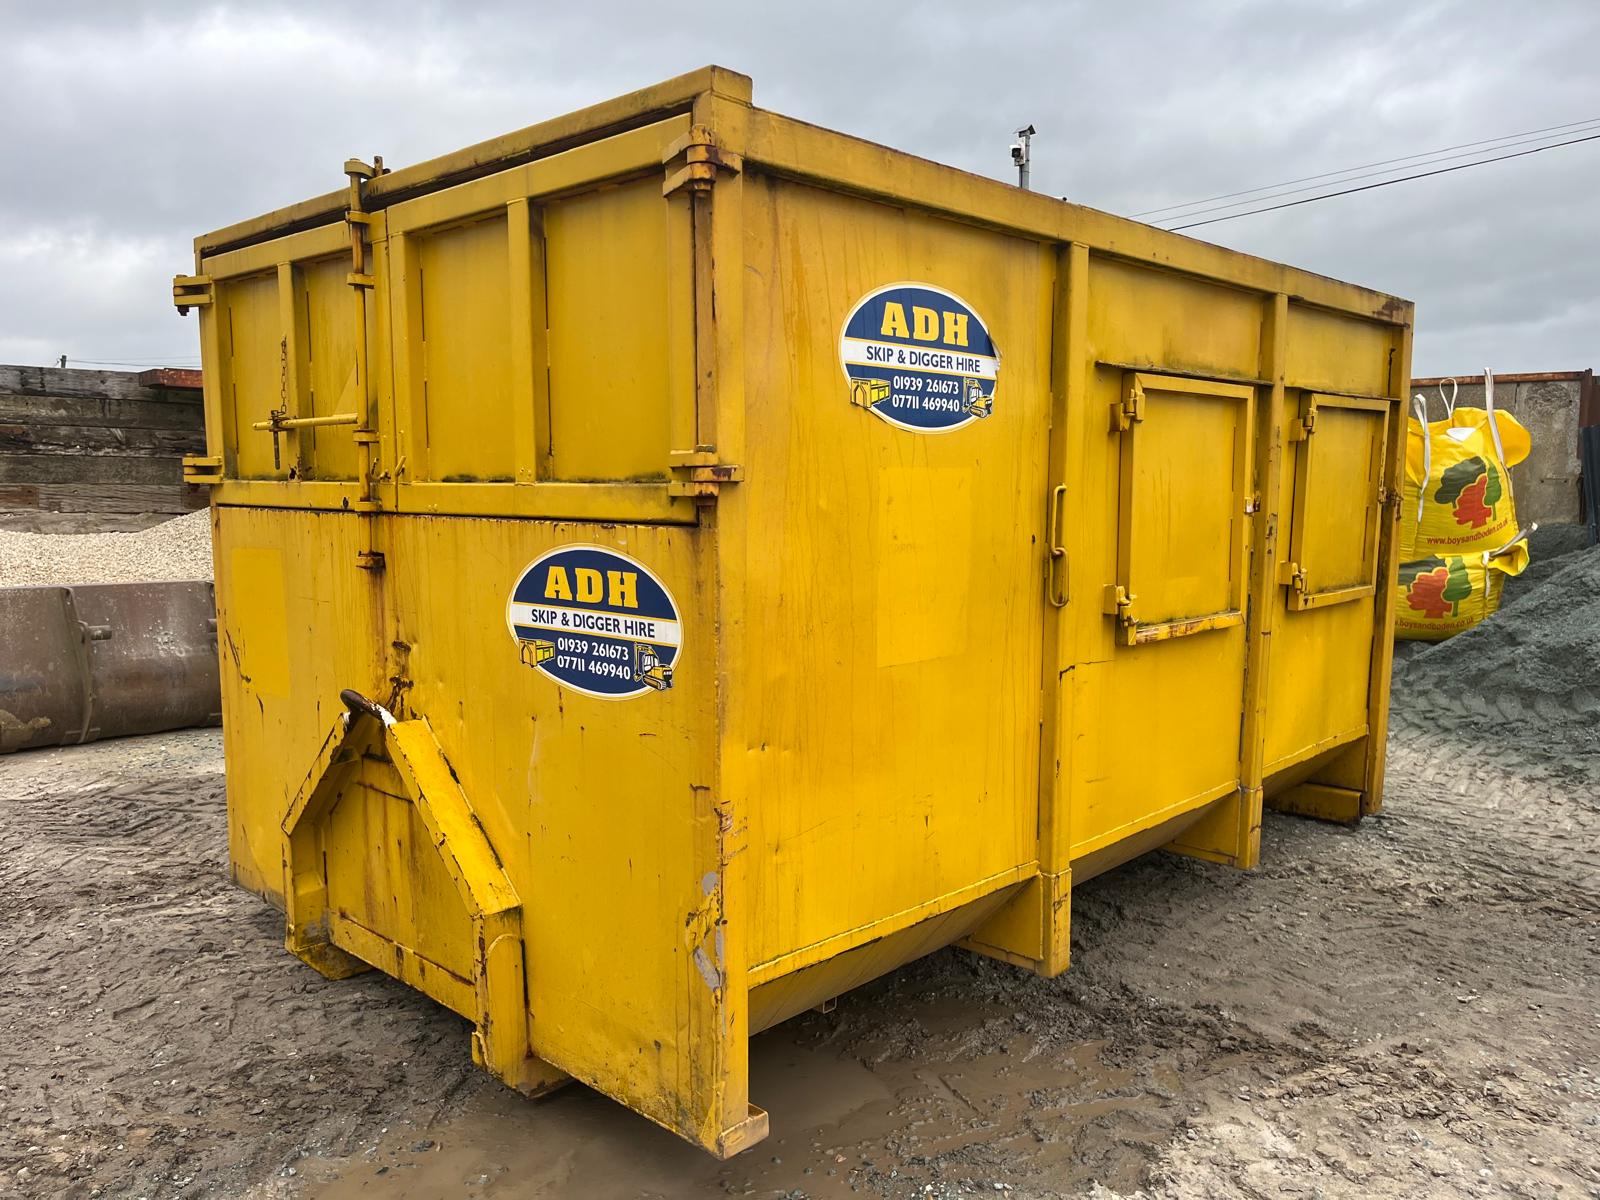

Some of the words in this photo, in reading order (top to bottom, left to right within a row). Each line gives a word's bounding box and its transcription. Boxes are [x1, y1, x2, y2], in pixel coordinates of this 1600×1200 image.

[880, 301, 969, 347] ADH
[866, 345, 894, 363] SKIP
[897, 350, 906, 364] &
[909, 352, 954, 370] DIGGER
[956, 357, 981, 373] HIRE
[893, 375, 923, 391] 01939
[926, 379, 959, 395] 261673
[892, 394, 919, 410] 07711
[922, 397, 960, 412] 469940
[1426, 518, 1509, 545] www.boysandboden.co.uk
[544, 565, 639, 609] ADH
[531, 608, 558, 624] SKIP
[561, 613, 570, 627] &
[573, 614, 621, 634] DIGGER
[624, 619, 656, 639] HIRE
[557, 637, 589, 654] 01939
[591, 642, 629, 661] 261673
[556, 655, 585, 672] 07711
[588, 660, 631, 680] 469940
